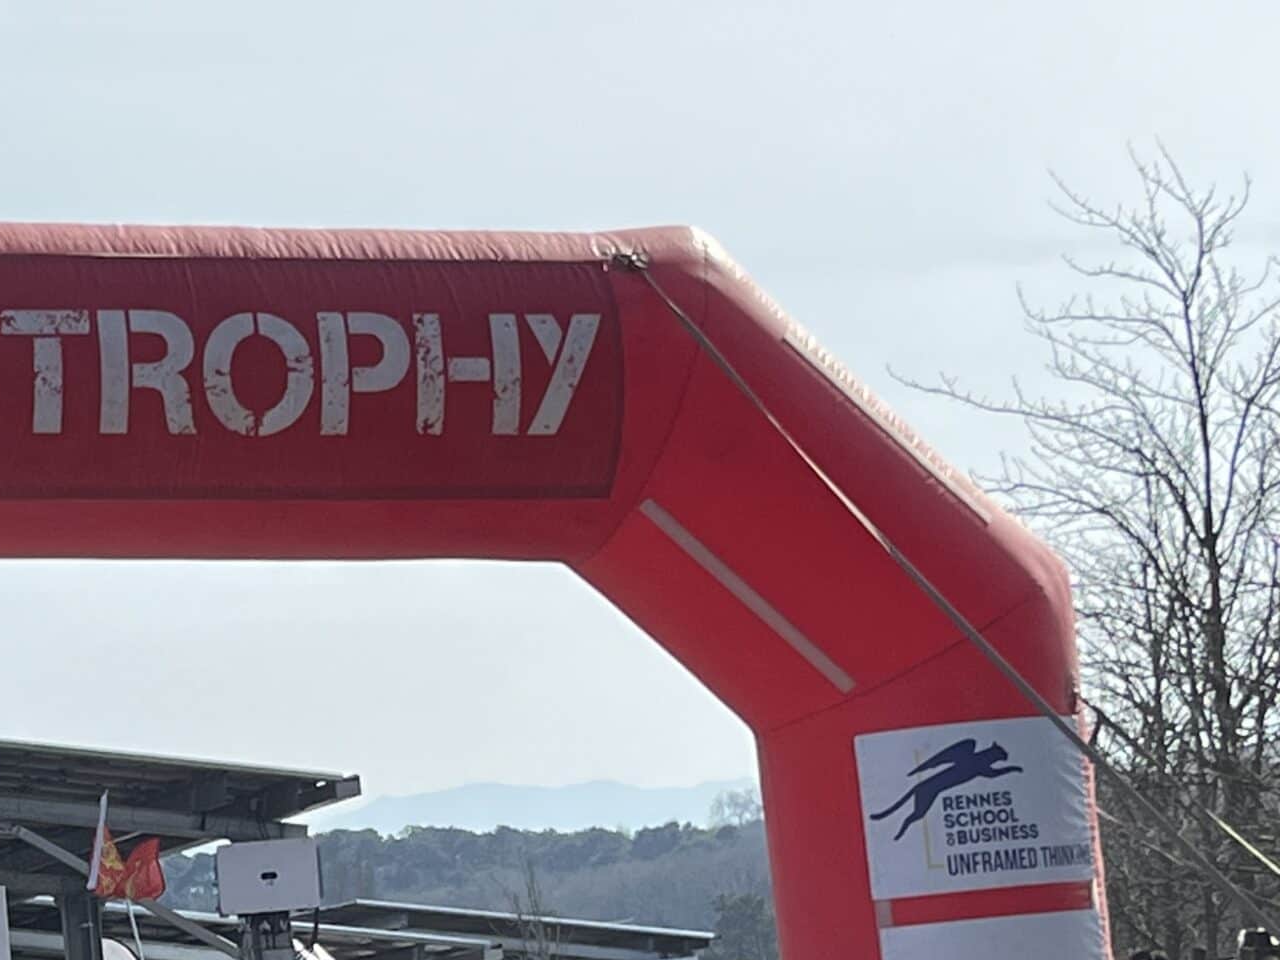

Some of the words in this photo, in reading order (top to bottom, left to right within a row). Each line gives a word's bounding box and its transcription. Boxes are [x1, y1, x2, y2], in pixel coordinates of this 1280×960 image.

[0, 309, 601, 439] TROPHY
[942, 791, 1012, 812] RENNES
[943, 808, 1019, 829] SCHOOL
[957, 824, 1039, 846] BUSINESS
[947, 847, 1038, 876] UNFRAMED
